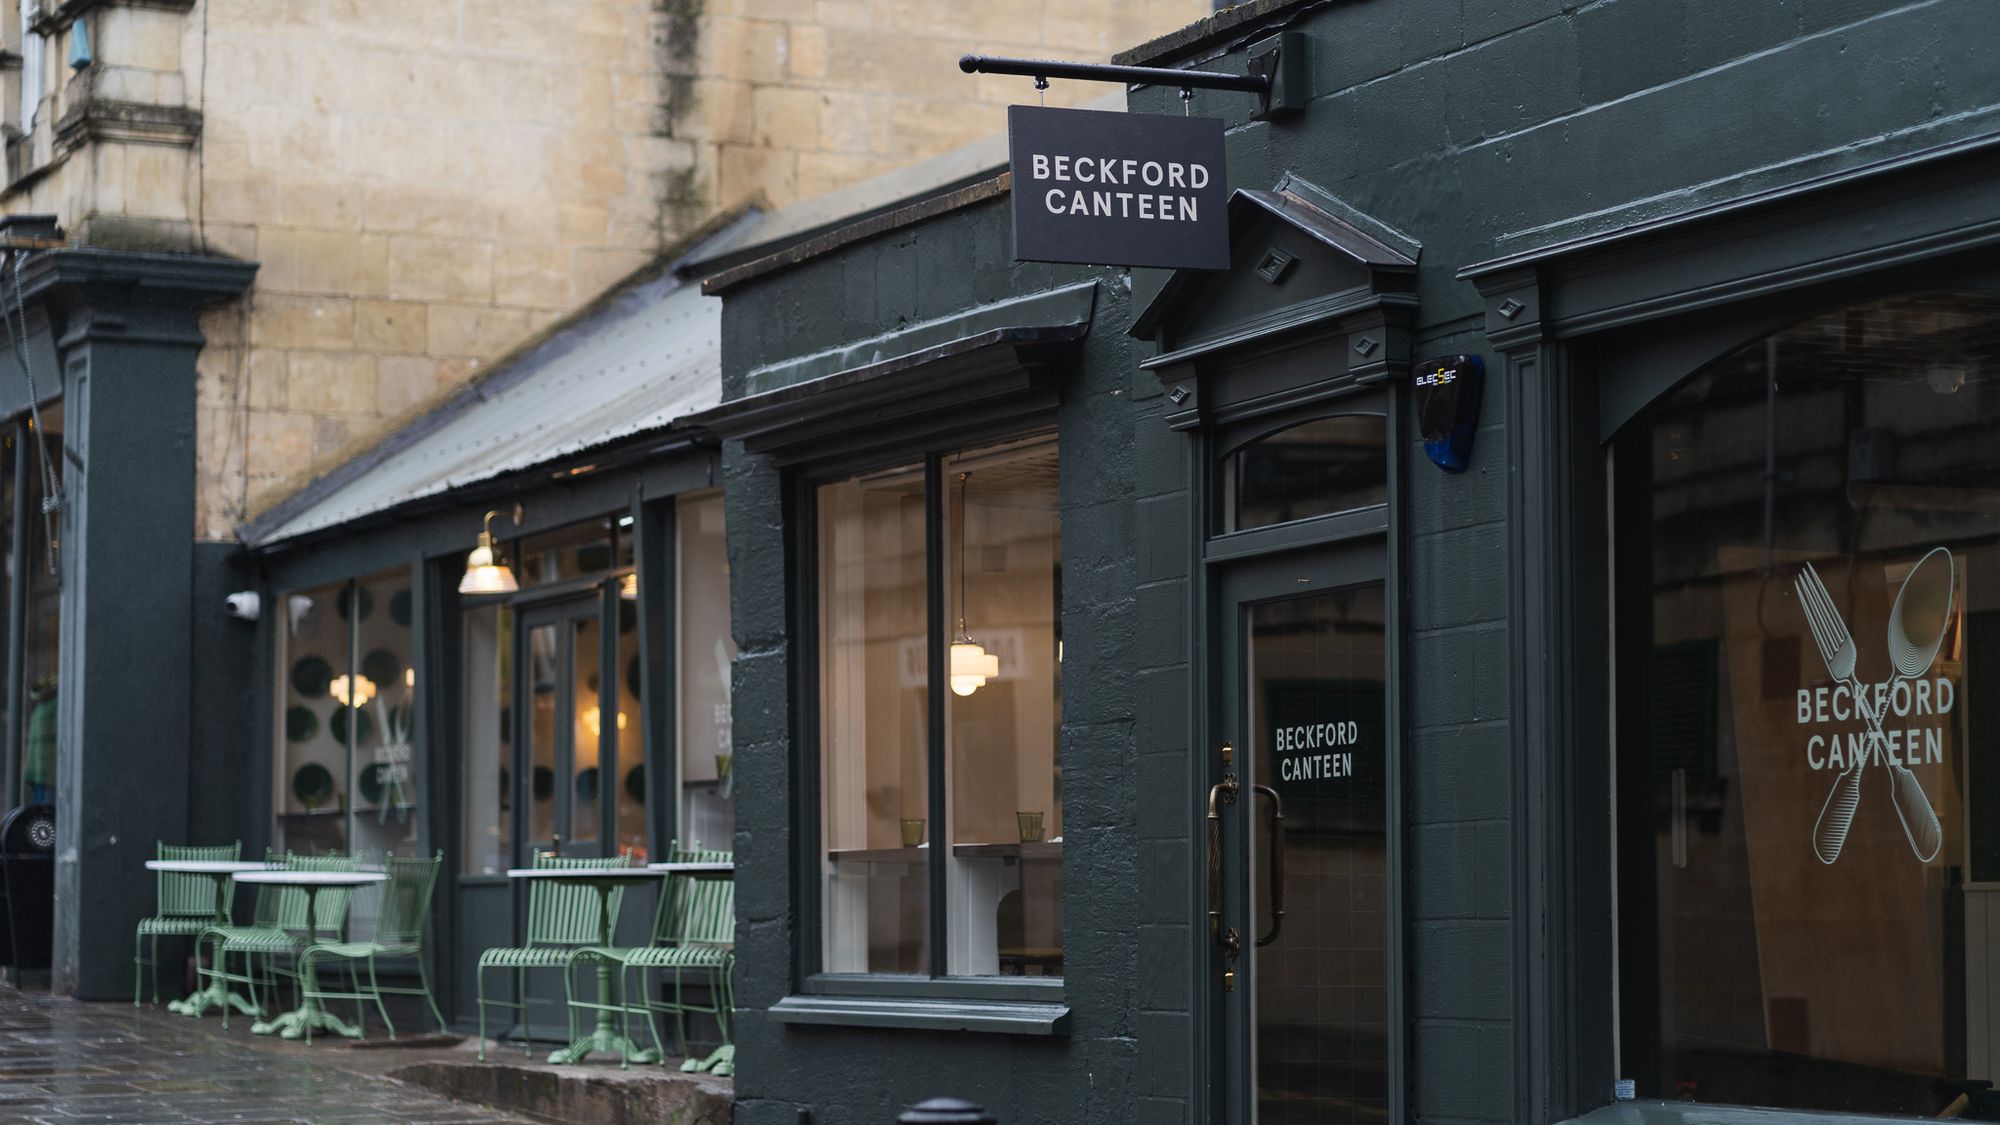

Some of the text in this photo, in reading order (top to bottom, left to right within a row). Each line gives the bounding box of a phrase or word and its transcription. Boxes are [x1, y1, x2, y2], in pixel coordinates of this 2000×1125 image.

[1032, 154, 1209, 189] BECKFORD
[1045, 188, 1198, 222] CANTEEN
[1797, 677, 1954, 724] BECKFORD
[1276, 720, 1358, 751] BECKFORD
[1806, 727, 1943, 770] CANTEEN
[1281, 752, 1352, 781] CANTEEN
